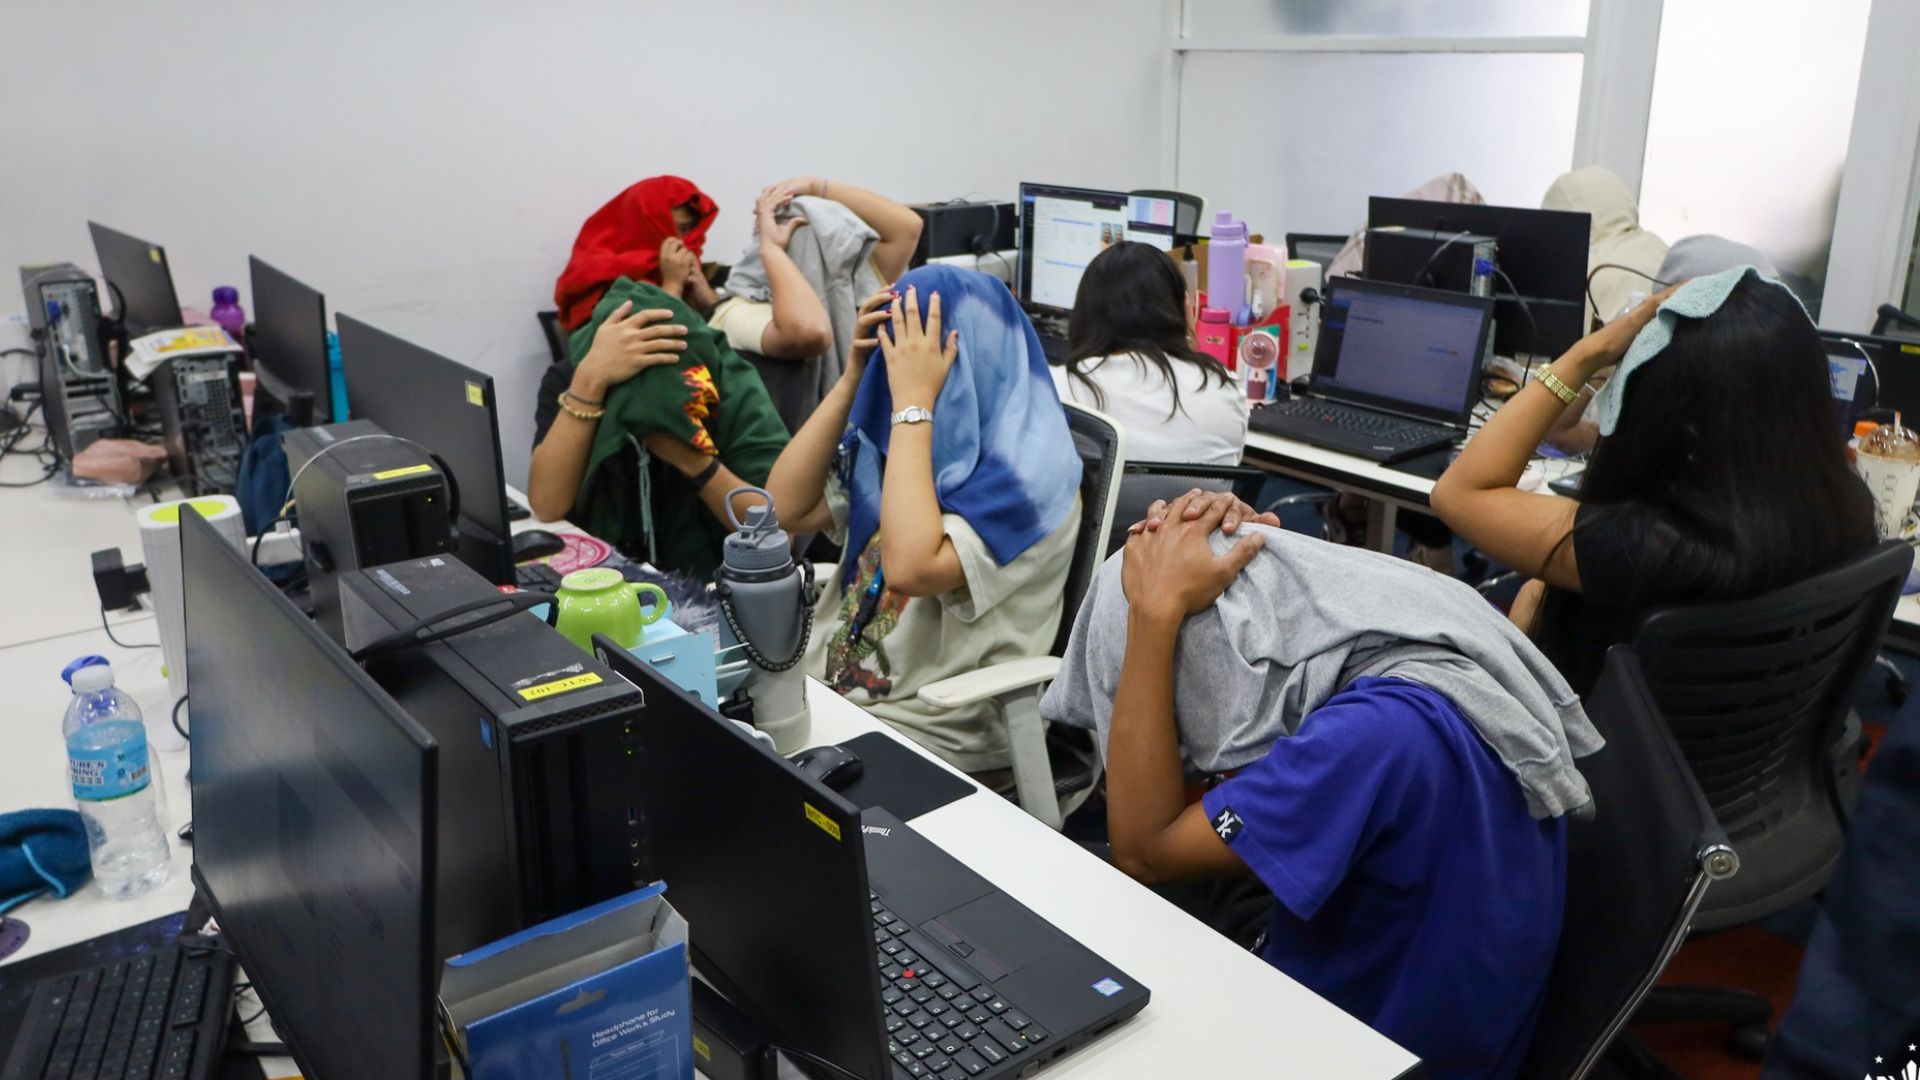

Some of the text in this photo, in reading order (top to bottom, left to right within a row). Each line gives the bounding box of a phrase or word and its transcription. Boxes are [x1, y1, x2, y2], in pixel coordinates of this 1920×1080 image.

[72, 767, 98, 777] RING
[861, 824, 891, 837] ThinkP
[592, 1008, 659, 1040] Headphone for
[592, 1033, 618, 1048] Office
[619, 1024, 642, 1037] Work
[649, 1009, 675, 1024] Study
